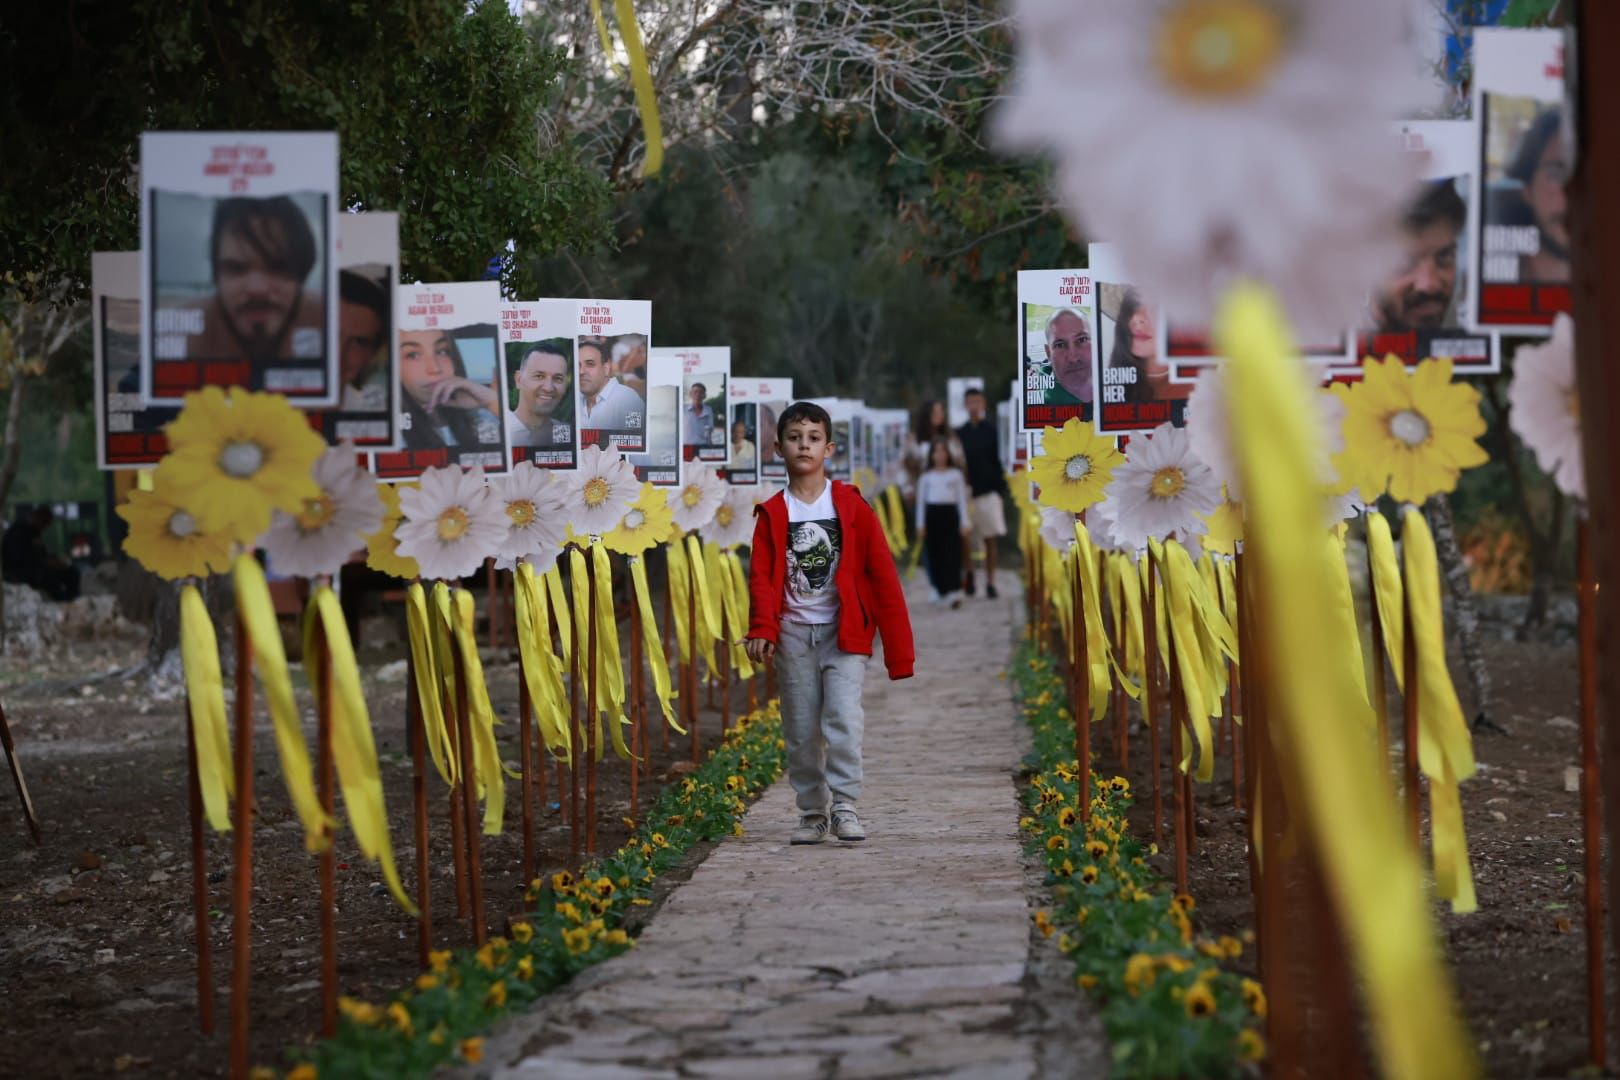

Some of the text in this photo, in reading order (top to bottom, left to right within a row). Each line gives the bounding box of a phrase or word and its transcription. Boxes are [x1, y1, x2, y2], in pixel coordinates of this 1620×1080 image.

[1059, 286, 1090, 295] ELAD KATZI
[502, 310, 518, 319] שרעב
[580, 316, 613, 325] ELI SHARABI
[512, 320, 538, 330] SHARABI
[1103, 366, 1137, 385] BRING
[1026, 374, 1055, 390] BRING
[1026, 390, 1045, 405] HIM
[1103, 385, 1125, 403] HER
